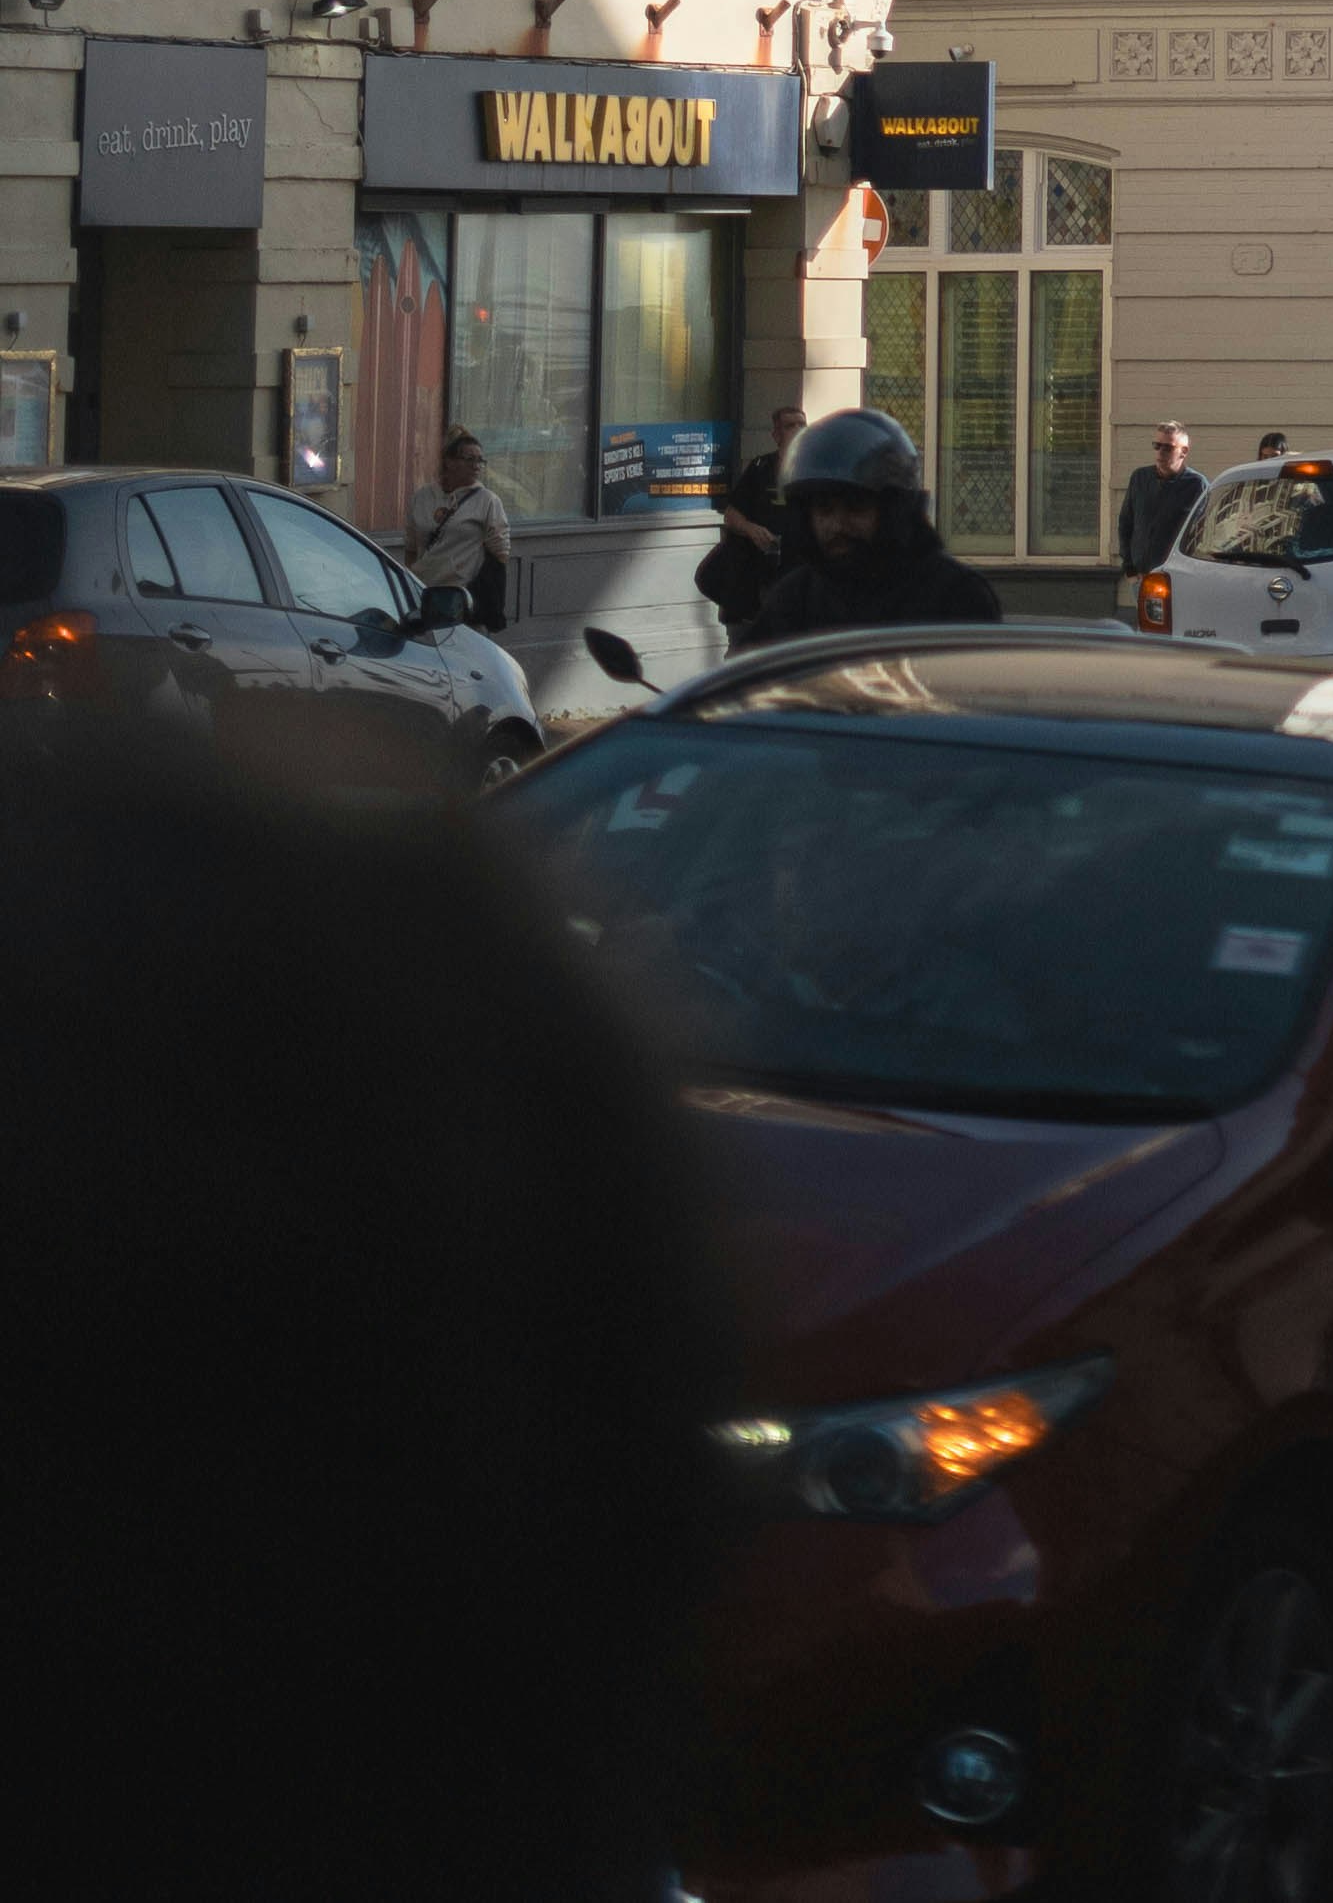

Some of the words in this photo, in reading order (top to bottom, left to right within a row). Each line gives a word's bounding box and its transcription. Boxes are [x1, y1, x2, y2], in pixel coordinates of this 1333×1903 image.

[99, 124, 137, 156] eat,
[143, 118, 204, 152] drink,
[209, 113, 252, 151] play
[488, 90, 717, 167] WALKABOUT
[881, 117, 980, 135] WALKABOUT
